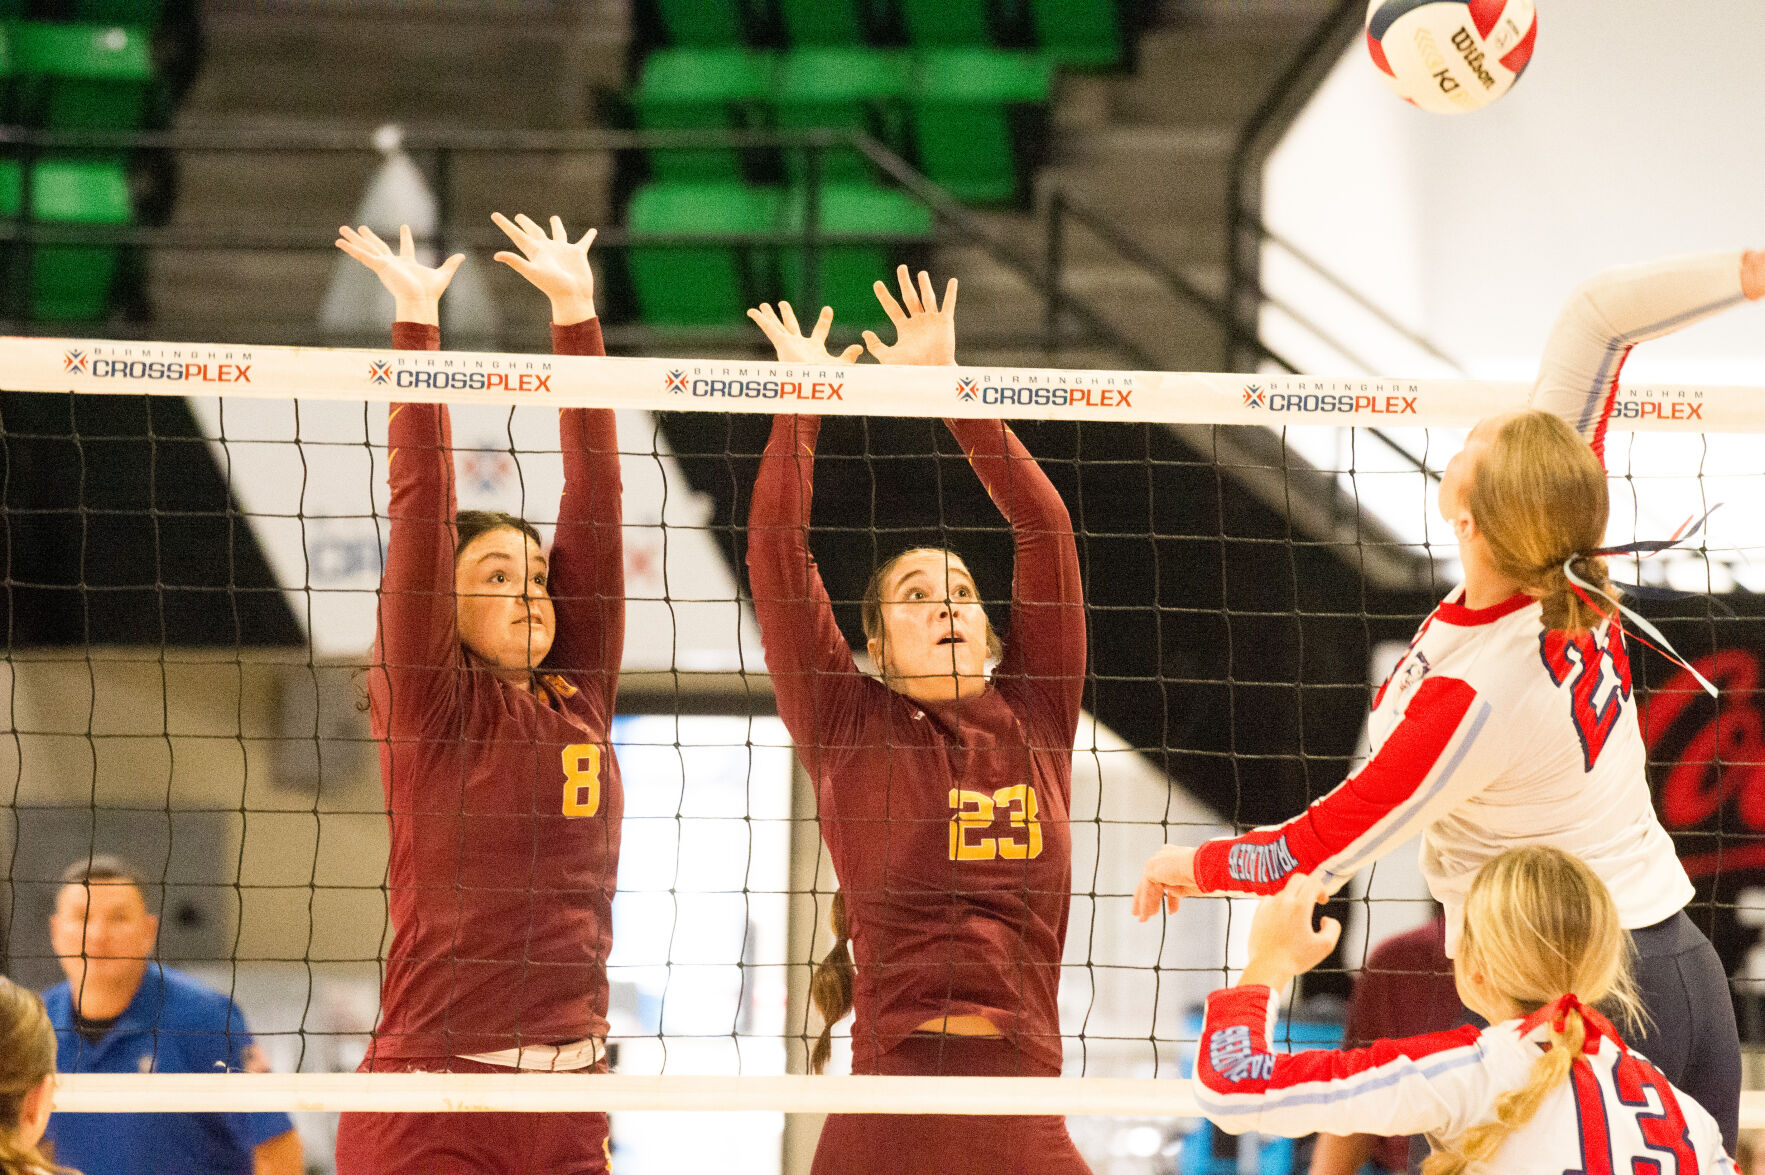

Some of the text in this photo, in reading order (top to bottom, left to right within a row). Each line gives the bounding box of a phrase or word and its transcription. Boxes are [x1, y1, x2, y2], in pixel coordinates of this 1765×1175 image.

[1451, 25, 1495, 90] Wilson
[94, 348, 252, 360] BIRMINGHAM
[398, 358, 552, 370] BIRMINGHAM
[92, 360, 252, 383] CROSSPLEX
[396, 370, 552, 392] CROSSPLEX
[694, 368, 845, 379] BIRMINGHAM
[984, 375, 1133, 385] BIRMINGHAM
[692, 379, 845, 401] CROSSPLEX
[982, 387, 1133, 408] CROSSPLEX
[1270, 383, 1418, 392] BIRMINGHAM
[1618, 389, 1703, 398] INGHAM
[1269, 394, 1418, 414] CROSSPLEX
[1610, 401, 1703, 420] SSPLEX
[561, 743, 601, 819] 8
[948, 784, 1043, 861] 23
[1563, 1050, 1701, 1175] 13
